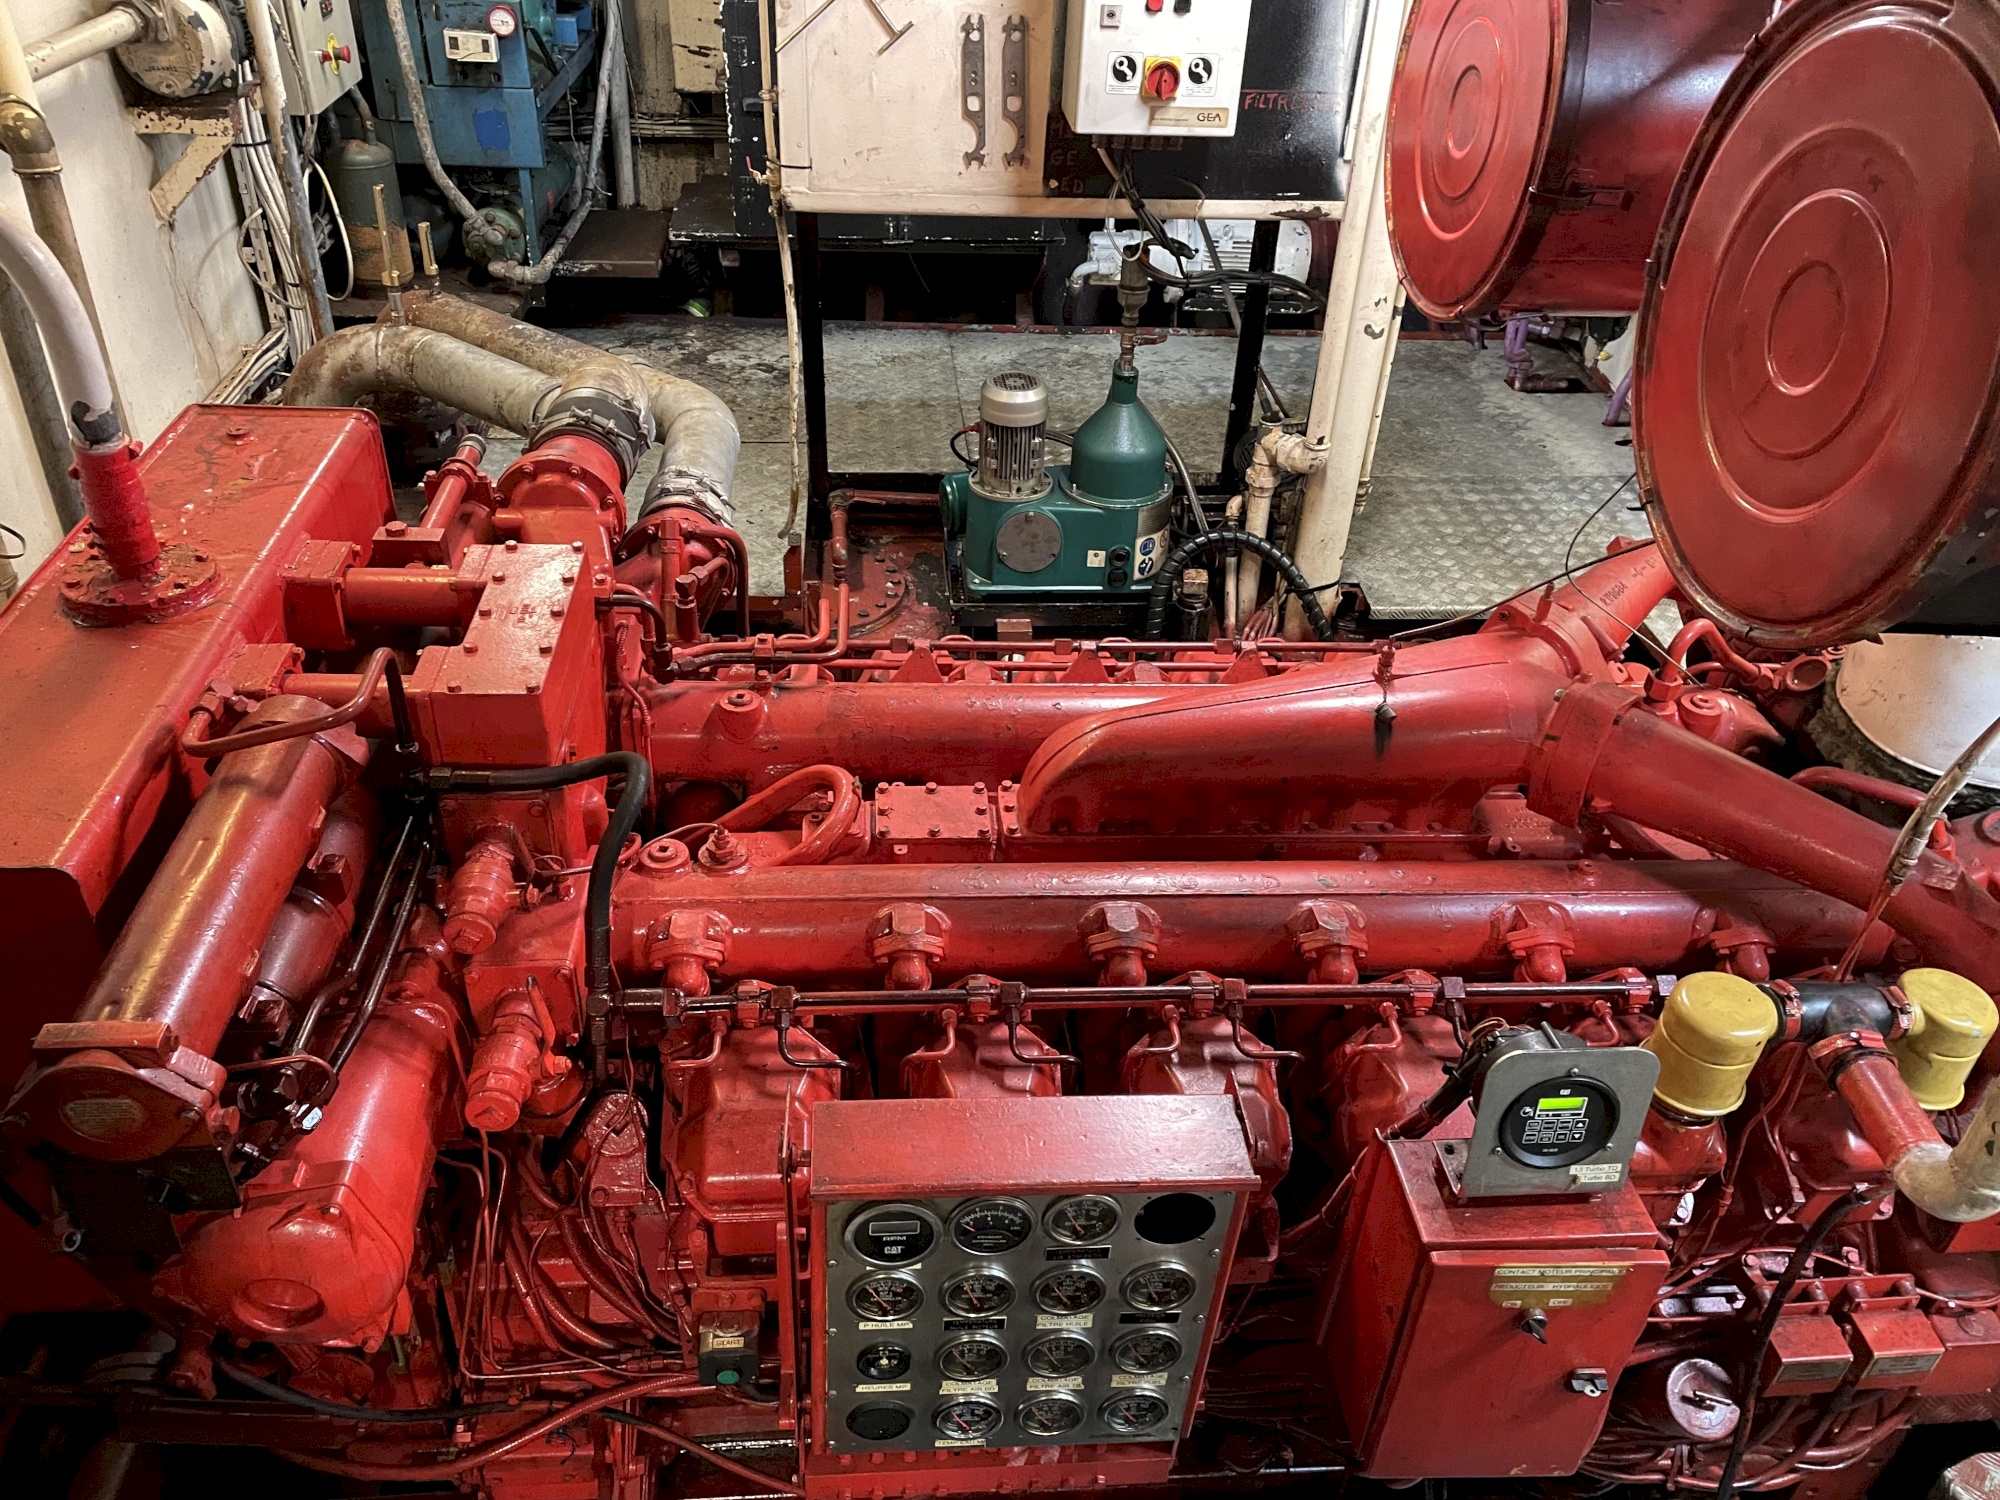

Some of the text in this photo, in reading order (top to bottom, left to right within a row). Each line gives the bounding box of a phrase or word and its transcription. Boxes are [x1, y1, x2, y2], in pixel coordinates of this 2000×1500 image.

[1196, 112, 1222, 122] GEA
[884, 1245, 903, 1255] CAT
[716, 1339, 742, 1347] START
